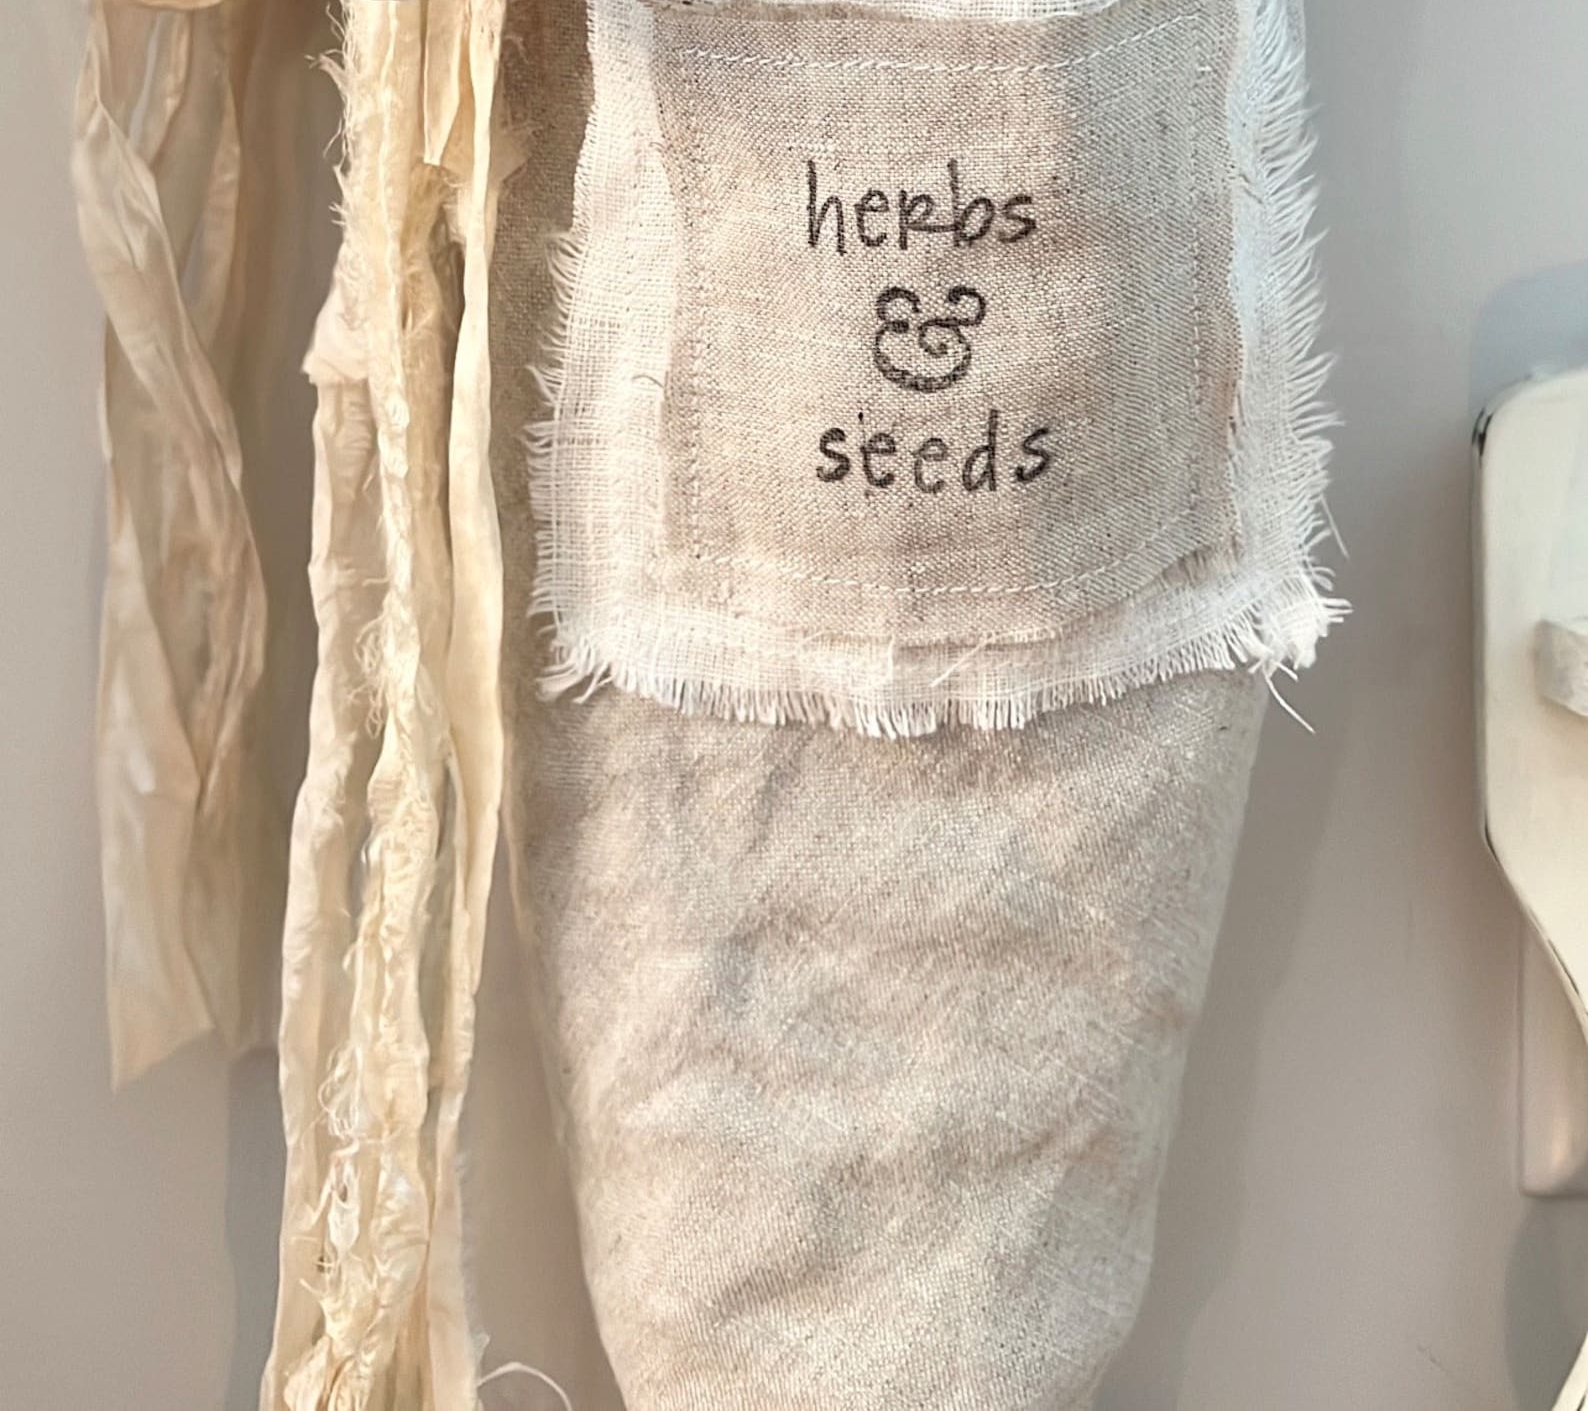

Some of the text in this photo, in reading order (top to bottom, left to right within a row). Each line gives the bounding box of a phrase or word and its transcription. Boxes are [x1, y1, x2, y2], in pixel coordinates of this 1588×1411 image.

[805, 158, 1038, 256] herbs
[872, 286, 987, 393] &
[815, 409, 1053, 493] seeds
